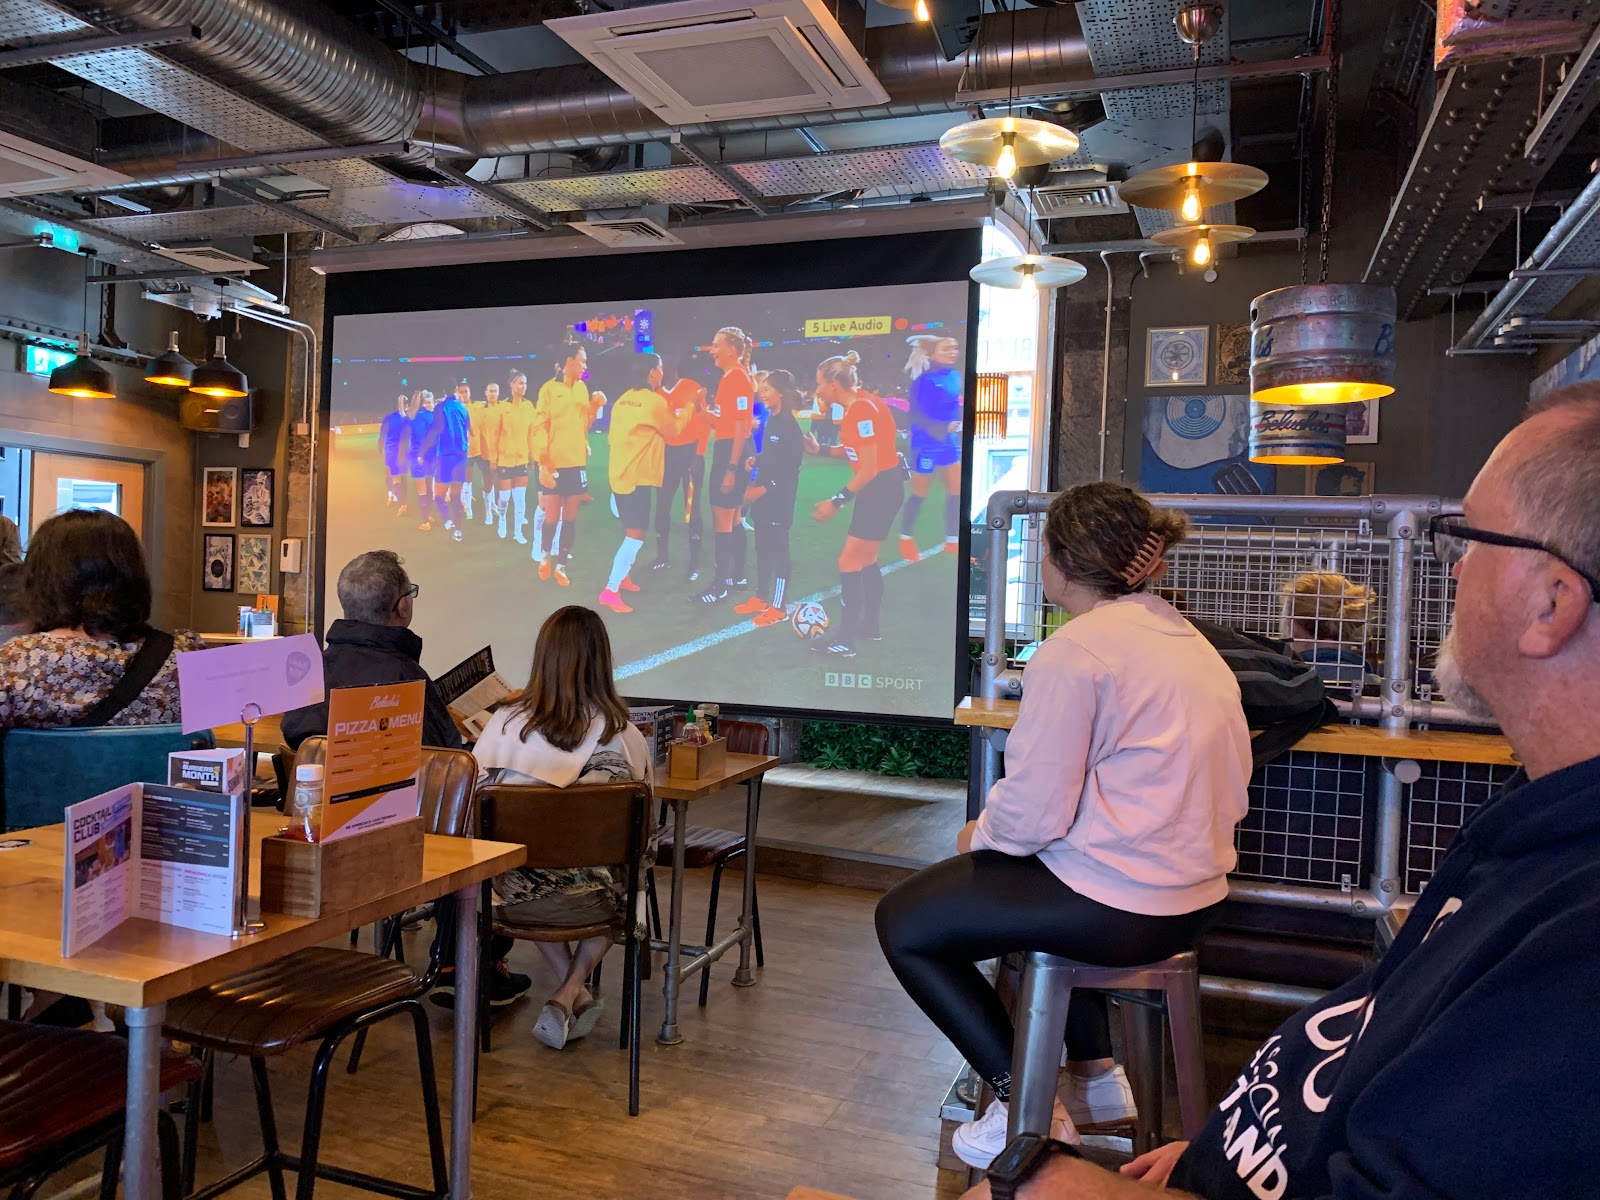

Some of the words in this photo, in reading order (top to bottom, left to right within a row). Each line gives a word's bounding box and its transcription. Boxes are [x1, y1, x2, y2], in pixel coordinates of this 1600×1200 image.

[813, 322, 820, 333] 5
[822, 321, 846, 333] Live
[849, 318, 883, 331] Audio
[825, 672, 872, 689] BBC
[875, 676, 924, 691] SPORT
[335, 720, 377, 736] PIZZA
[388, 712, 422, 729] MENU
[182, 770, 219, 782] MONTH
[74, 807, 111, 830] COCKTAIL
[74, 821, 100, 844] CLUB
